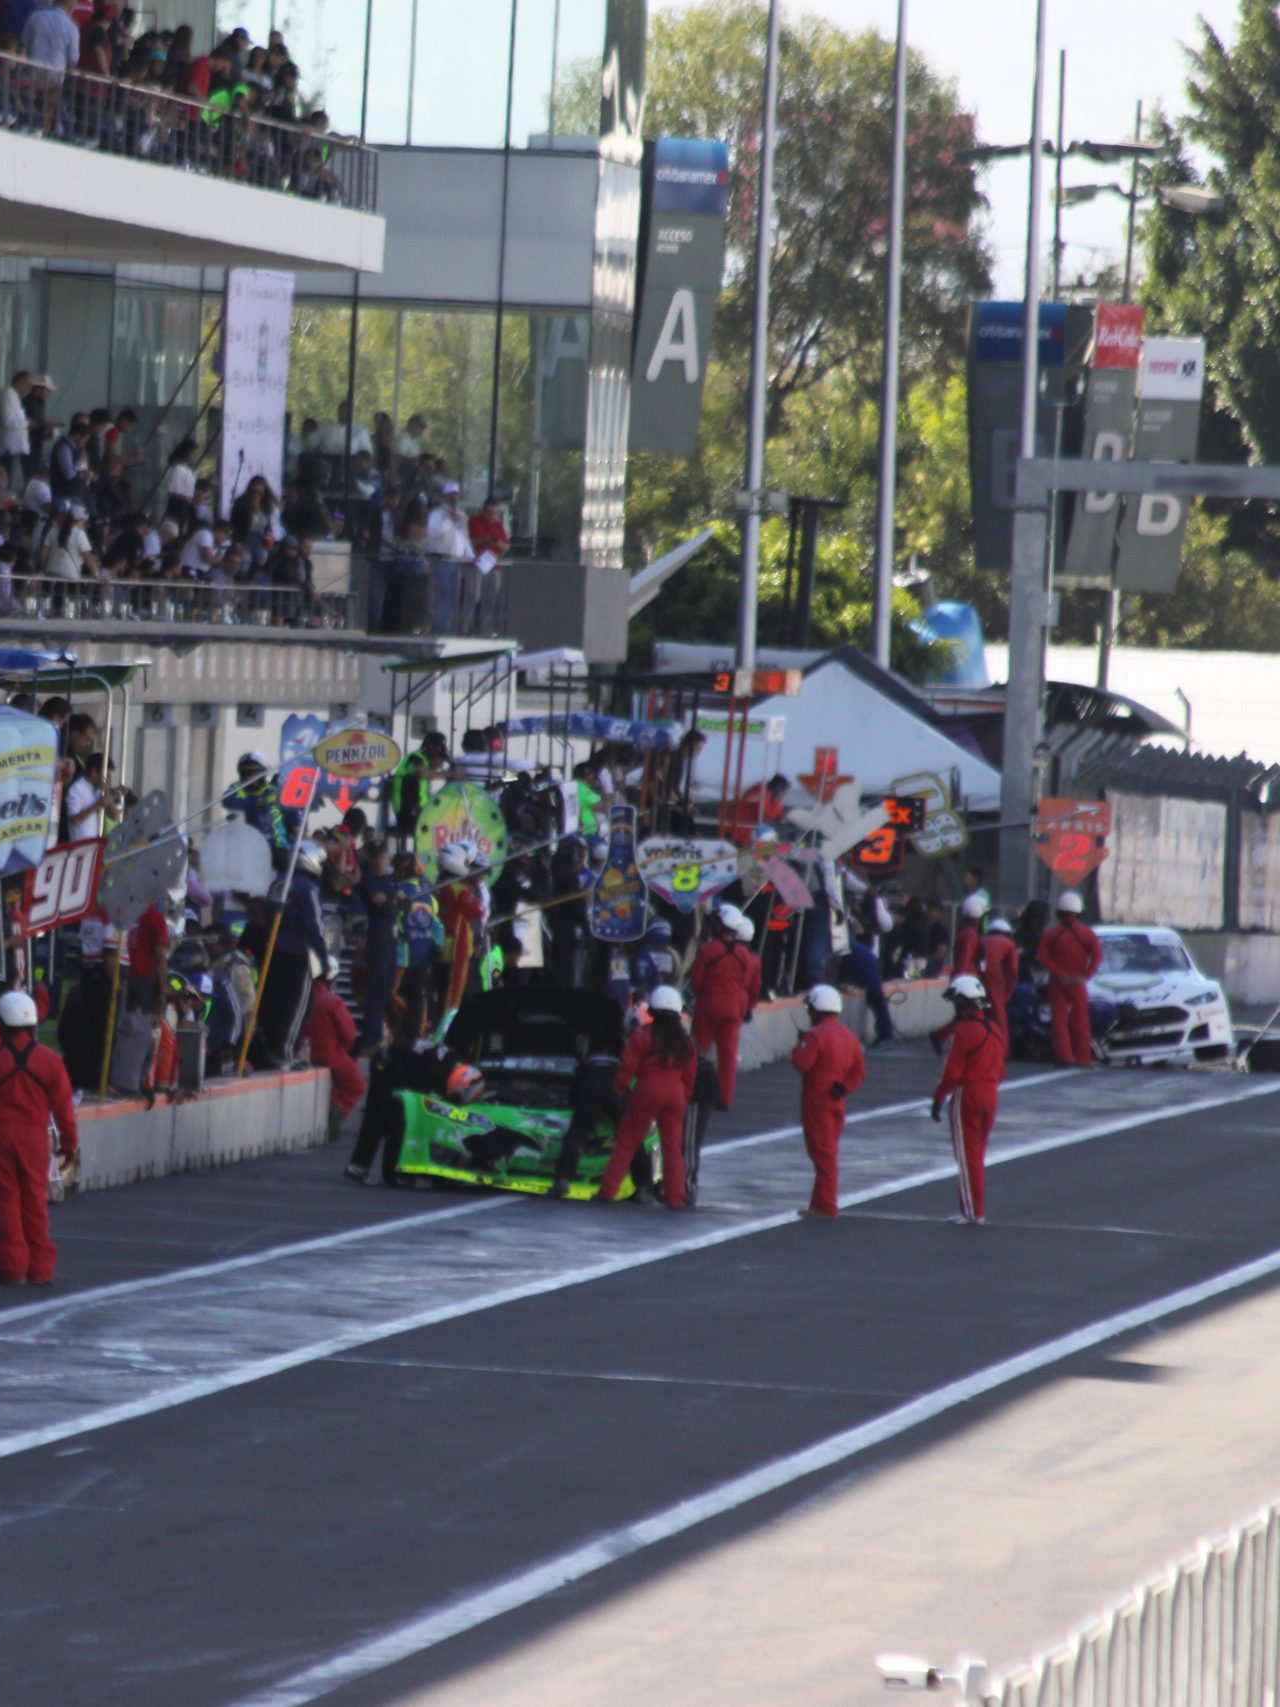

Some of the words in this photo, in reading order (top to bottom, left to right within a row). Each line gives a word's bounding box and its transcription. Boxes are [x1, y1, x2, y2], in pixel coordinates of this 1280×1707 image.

[656, 167, 717, 185] citibanamex
[658, 229, 692, 243] ACCESO
[646, 289, 699, 384] A
[713, 673, 731, 692] 3
[151, 703, 164, 722] 6
[199, 703, 211, 722] 5
[244, 703, 257, 721] 4
[337, 703, 349, 720] 3
[325, 743, 387, 764] PENNZOIL
[280, 767, 320, 808] 6
[859, 828, 896, 863] 3
[1053, 833, 1091, 870] 2
[27, 842, 99, 928] 90
[671, 863, 702, 892] 8
